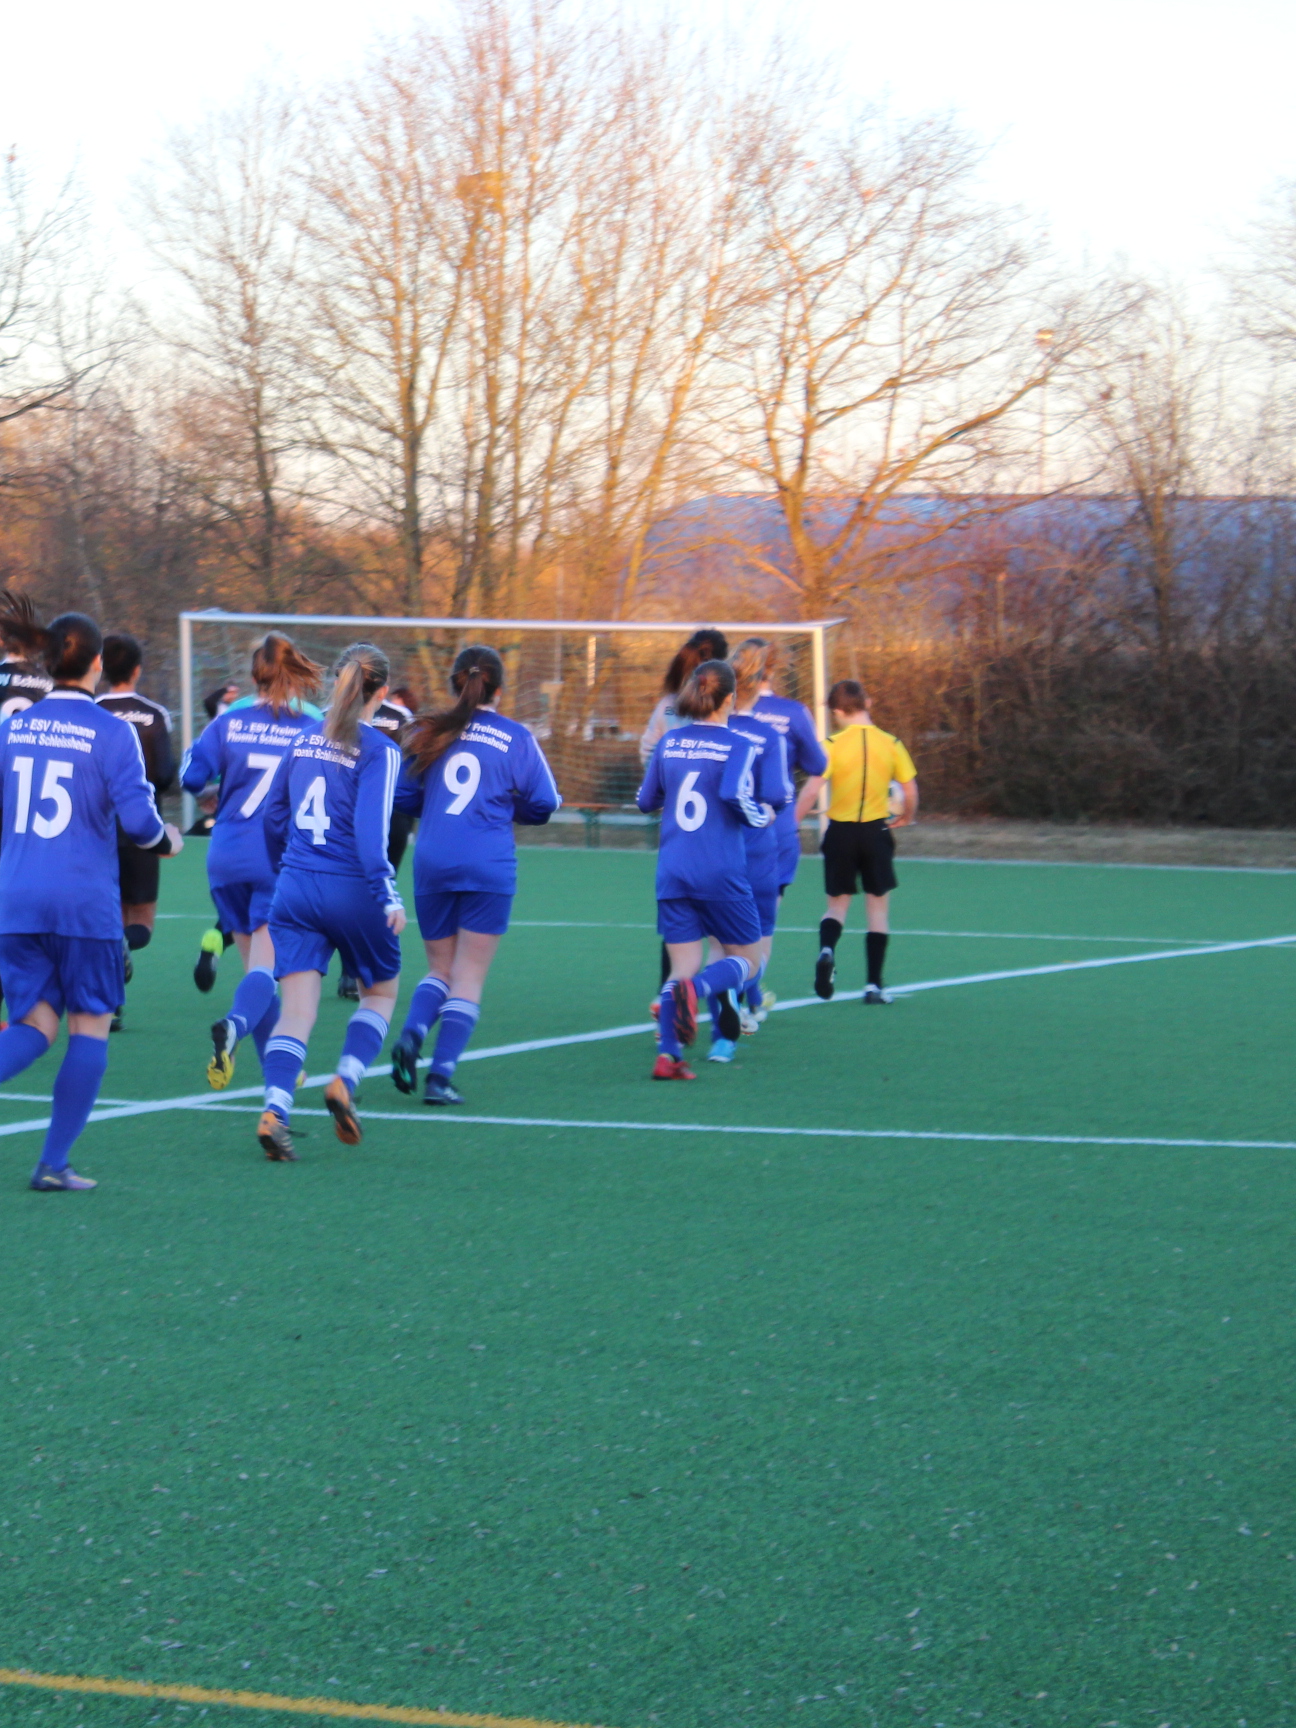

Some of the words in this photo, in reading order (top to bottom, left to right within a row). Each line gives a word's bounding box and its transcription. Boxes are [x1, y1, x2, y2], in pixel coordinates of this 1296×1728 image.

[10, 718, 24, 731] SG
[29, 718, 52, 732] ESV
[52, 720, 97, 740] Freimann
[249, 721, 271, 735] ESV
[472, 722, 503, 743] Freimann
[38, 732, 93, 754] Schleissheim
[309, 734, 327, 747] ESV
[460, 731, 509, 754] Schleissheim
[680, 738, 698, 749] ESV
[240, 752, 283, 819] 7
[444, 752, 482, 816] 9
[12, 755, 74, 840] 15
[675, 771, 708, 832] 6
[295, 776, 331, 846] 4
